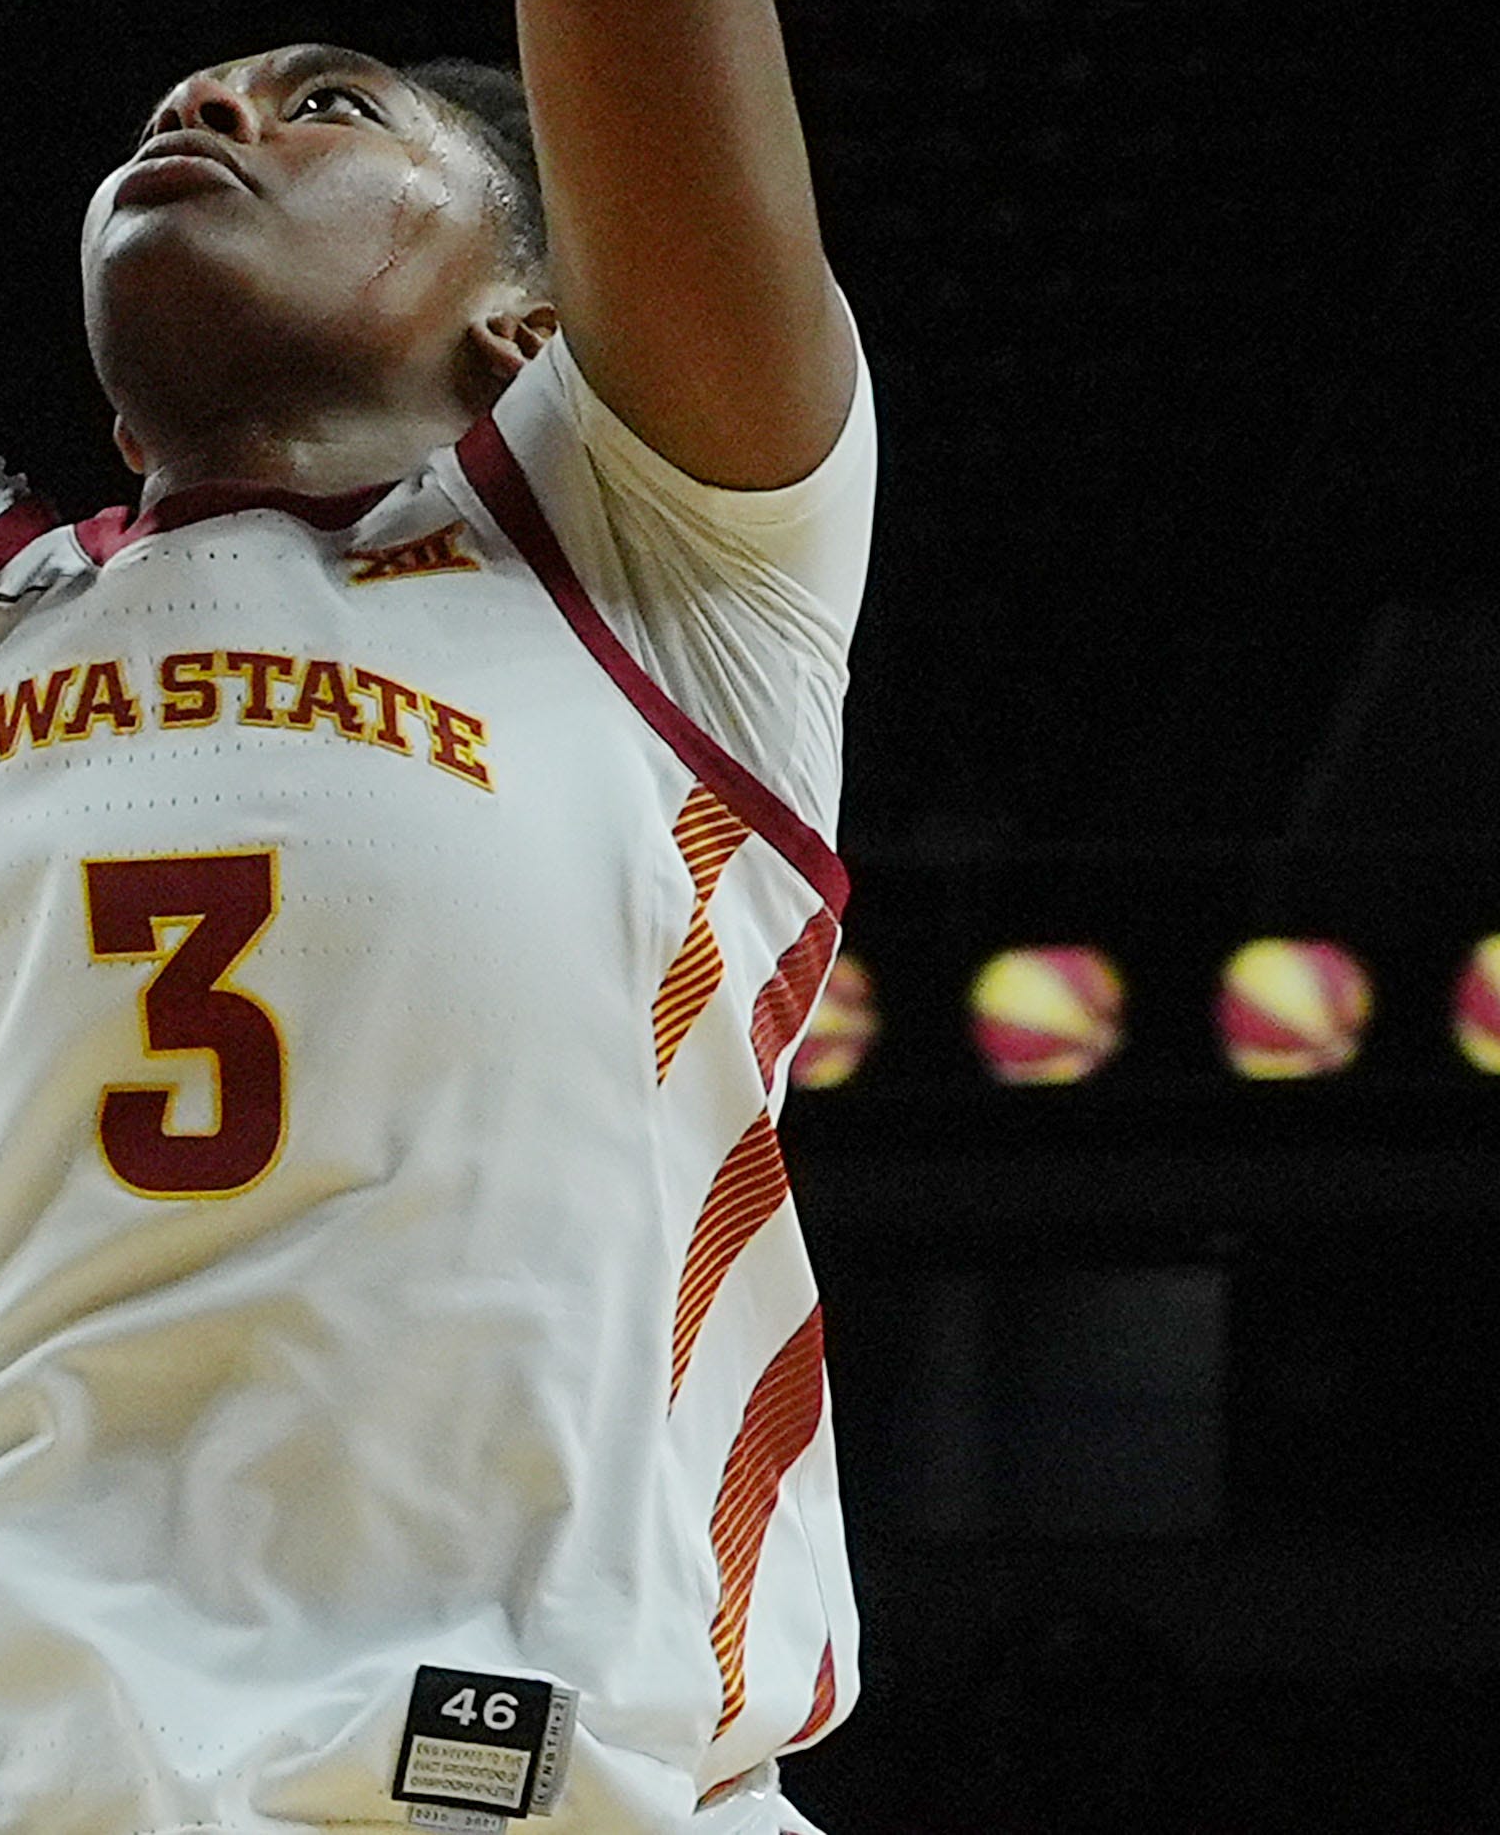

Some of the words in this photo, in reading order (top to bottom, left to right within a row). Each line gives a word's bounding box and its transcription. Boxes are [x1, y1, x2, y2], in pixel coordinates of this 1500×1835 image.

[159, 650, 496, 793] STATE
[81, 846, 289, 1200] 3
[441, 1688, 519, 1731] 46
